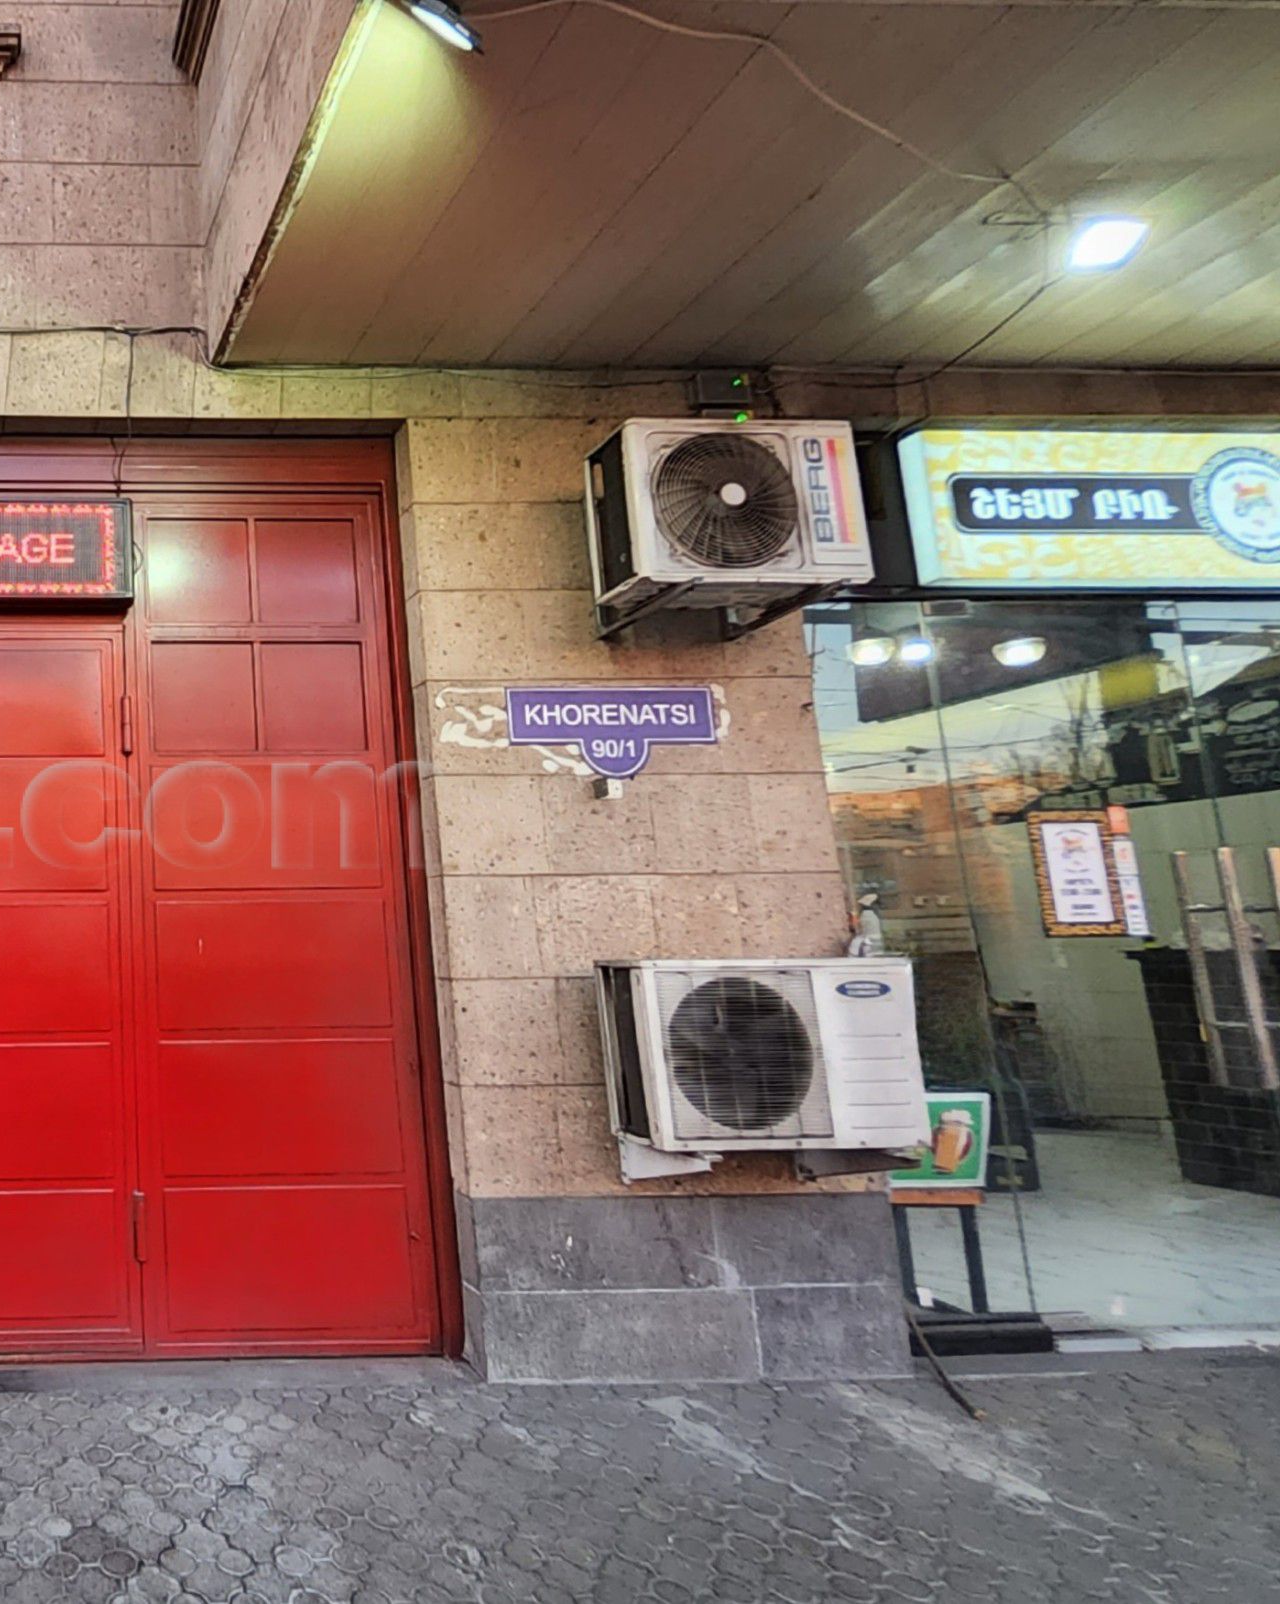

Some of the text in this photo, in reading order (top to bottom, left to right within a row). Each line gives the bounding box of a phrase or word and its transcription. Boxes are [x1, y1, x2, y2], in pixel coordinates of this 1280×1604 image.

[803, 438, 834, 543] BERG
[1092, 487, 1181, 520] ԲԻՌ
[524, 703, 696, 726] KHORENATSI
[591, 738, 637, 759] 90/1
